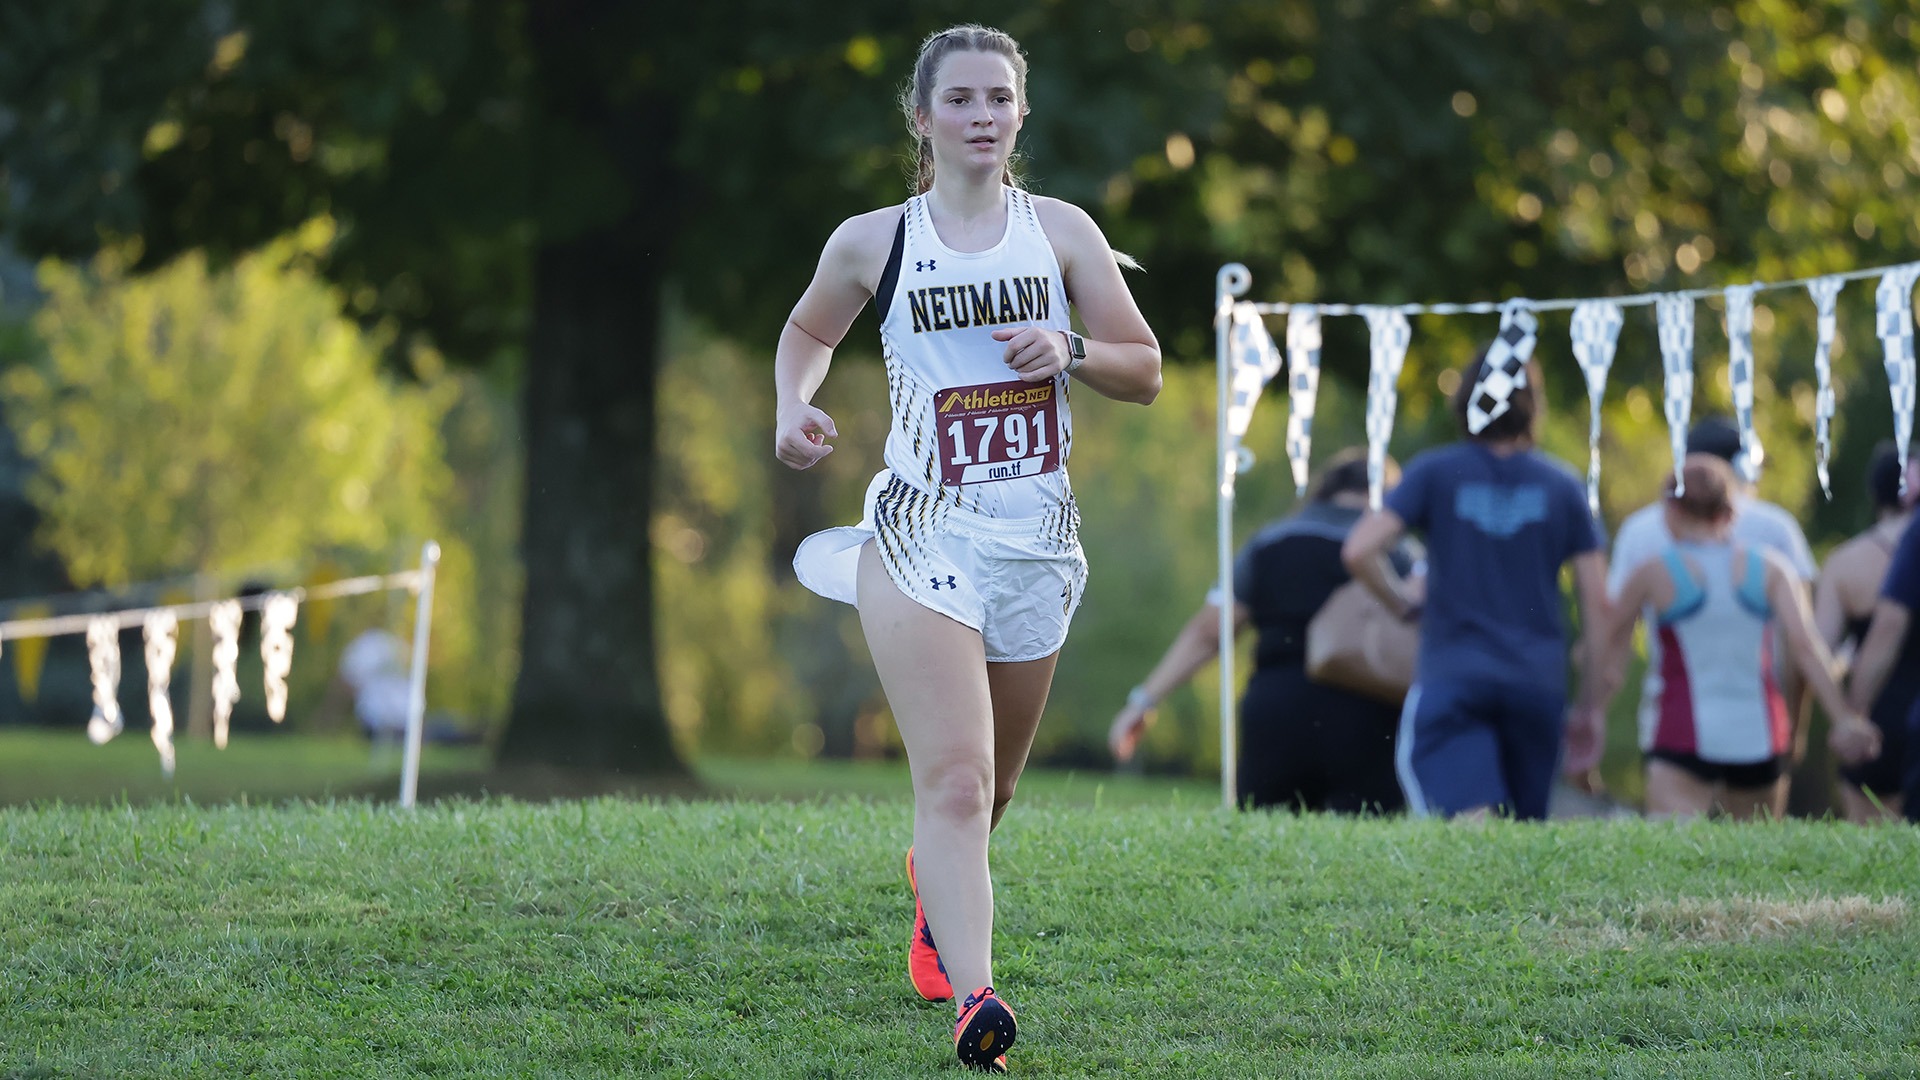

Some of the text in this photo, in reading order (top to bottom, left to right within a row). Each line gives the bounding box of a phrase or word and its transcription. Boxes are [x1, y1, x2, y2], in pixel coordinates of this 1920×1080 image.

[907, 276, 1049, 334] NEUMANN
[947, 410, 1051, 466] 1791
[988, 461, 1021, 479] run.tf
